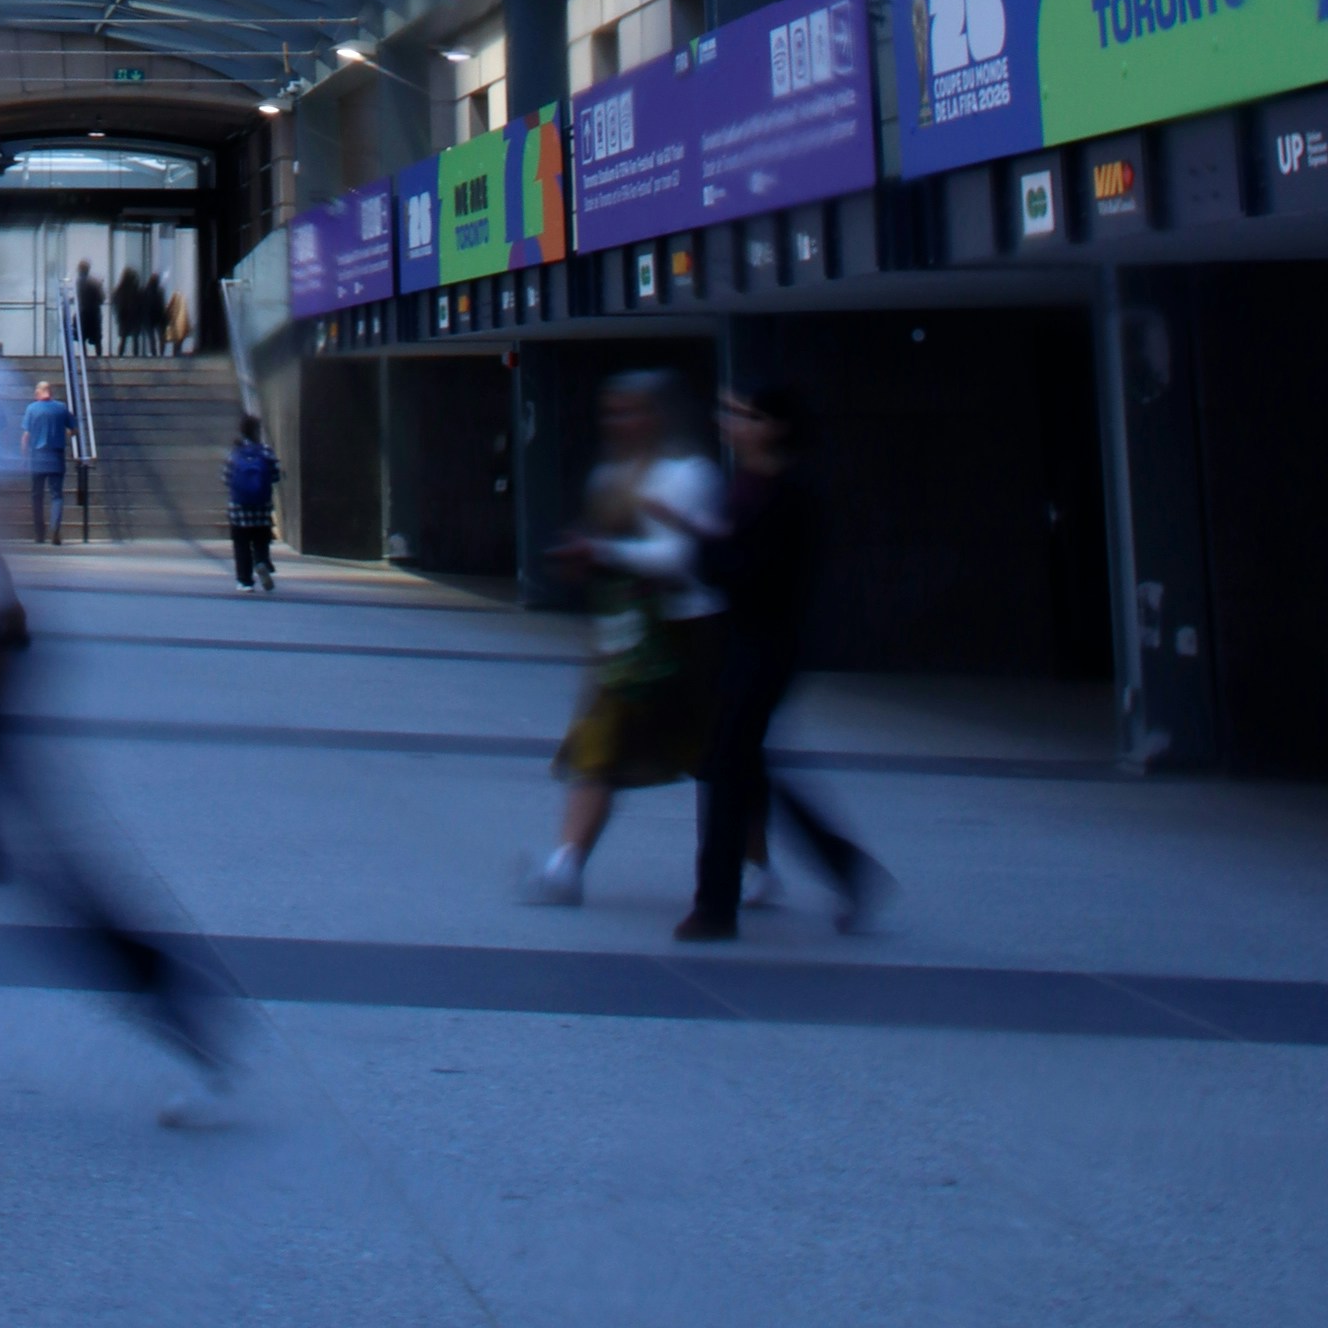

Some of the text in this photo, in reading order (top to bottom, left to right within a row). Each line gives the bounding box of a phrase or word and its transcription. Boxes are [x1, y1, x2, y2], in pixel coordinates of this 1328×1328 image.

[934, 56, 1009, 98] COUPE DU MONDE
[935, 80, 1010, 123] DE LA FIFA 2026
[1277, 132, 1304, 175] UP
